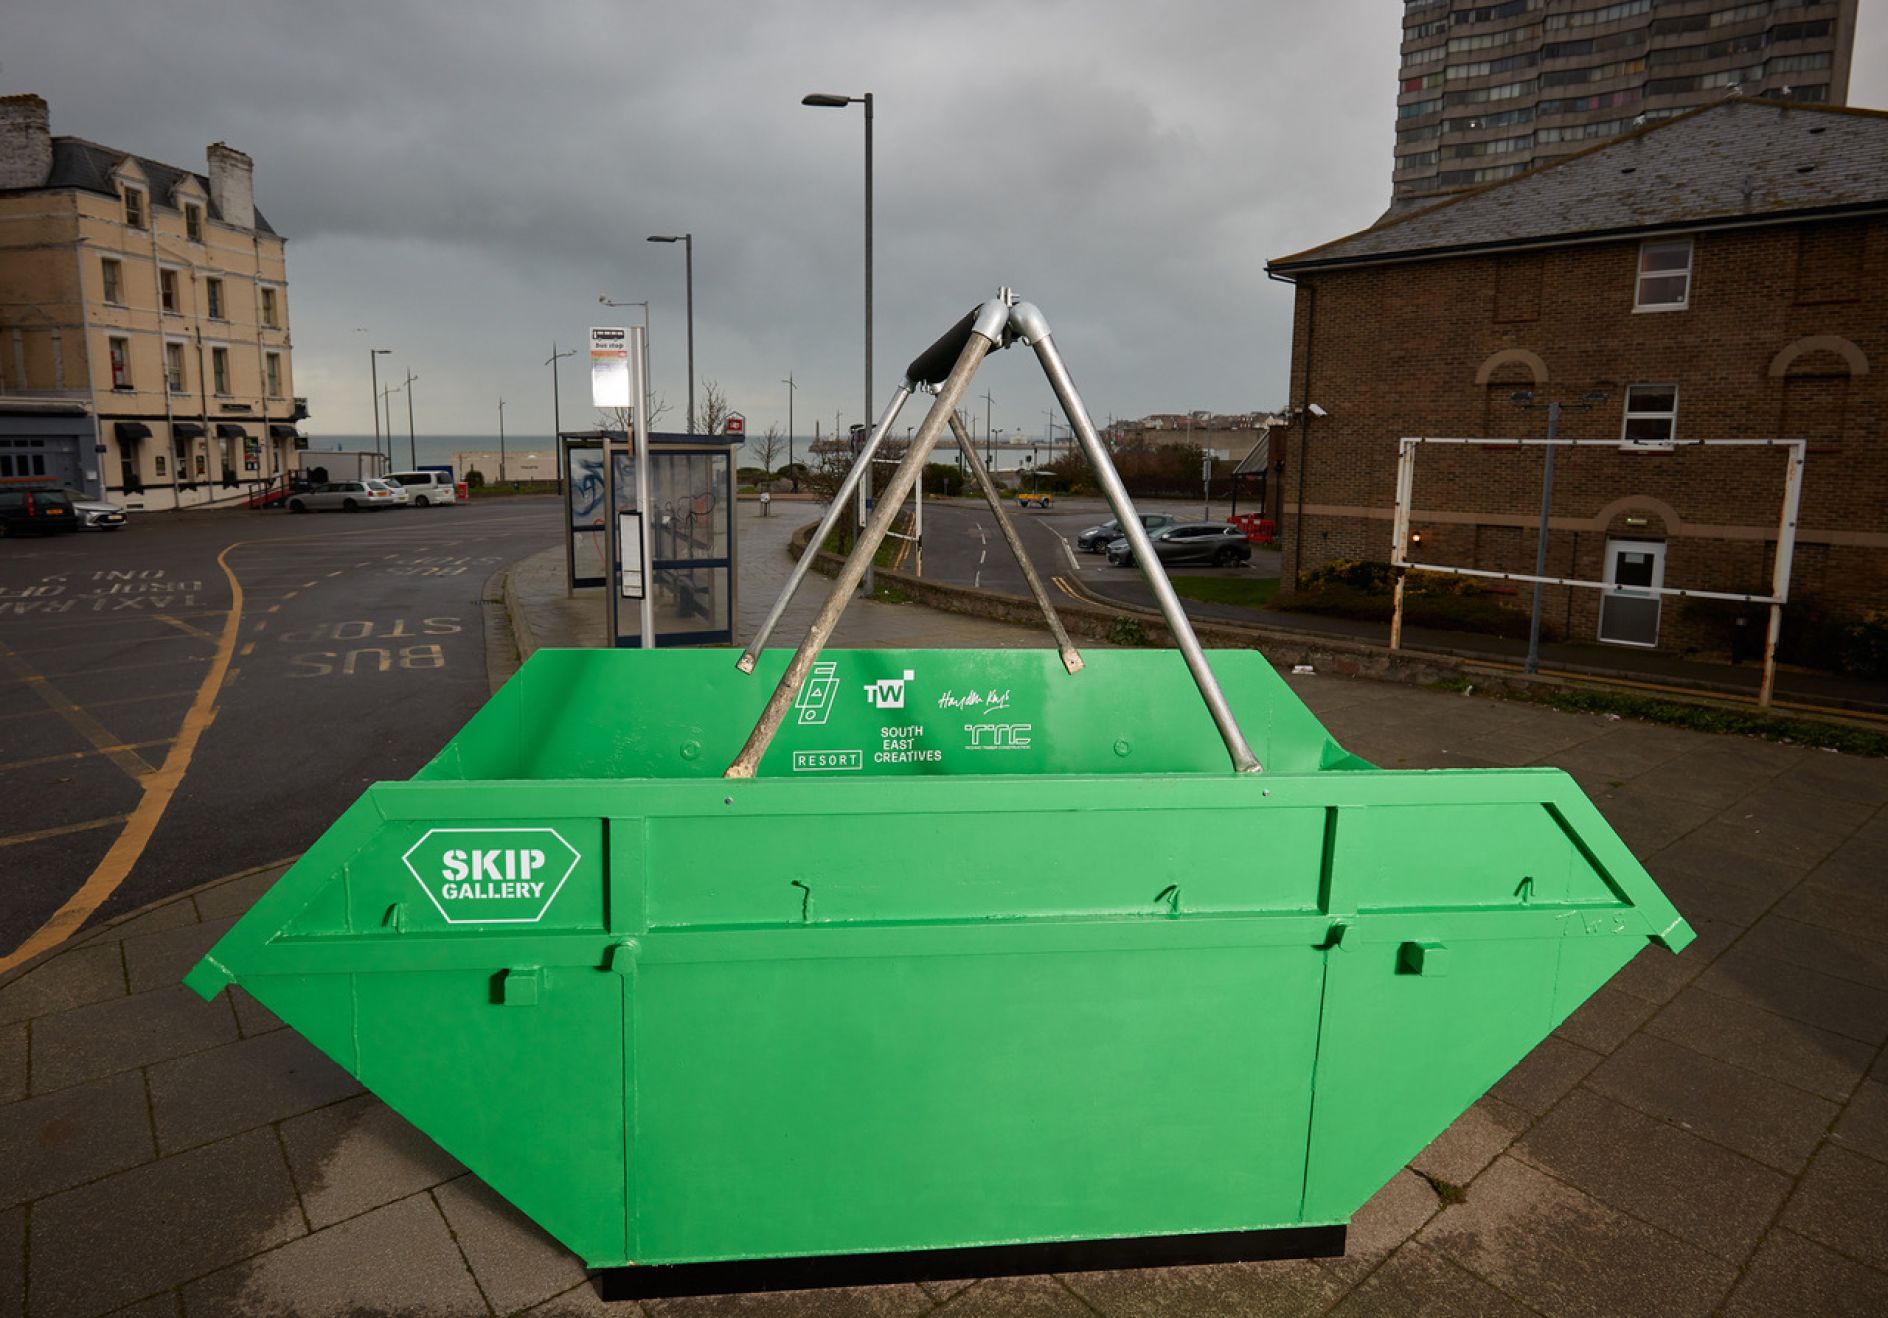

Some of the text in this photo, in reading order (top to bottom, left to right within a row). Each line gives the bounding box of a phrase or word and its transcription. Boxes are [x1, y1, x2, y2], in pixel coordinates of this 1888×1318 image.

[609, 342, 624, 350] stop
[91, 594, 206, 612] TAXI
[279, 617, 463, 643] STOP
[286, 643, 446, 679] BUS
[863, 679, 905, 708] TW
[880, 725, 924, 738] SOUTH
[882, 739, 914, 751] EAST
[797, 753, 858, 767] RESORT
[874, 750, 943, 764] CREATIVES
[441, 848, 546, 882] SKIP
[441, 882, 546, 900] GALLERY
